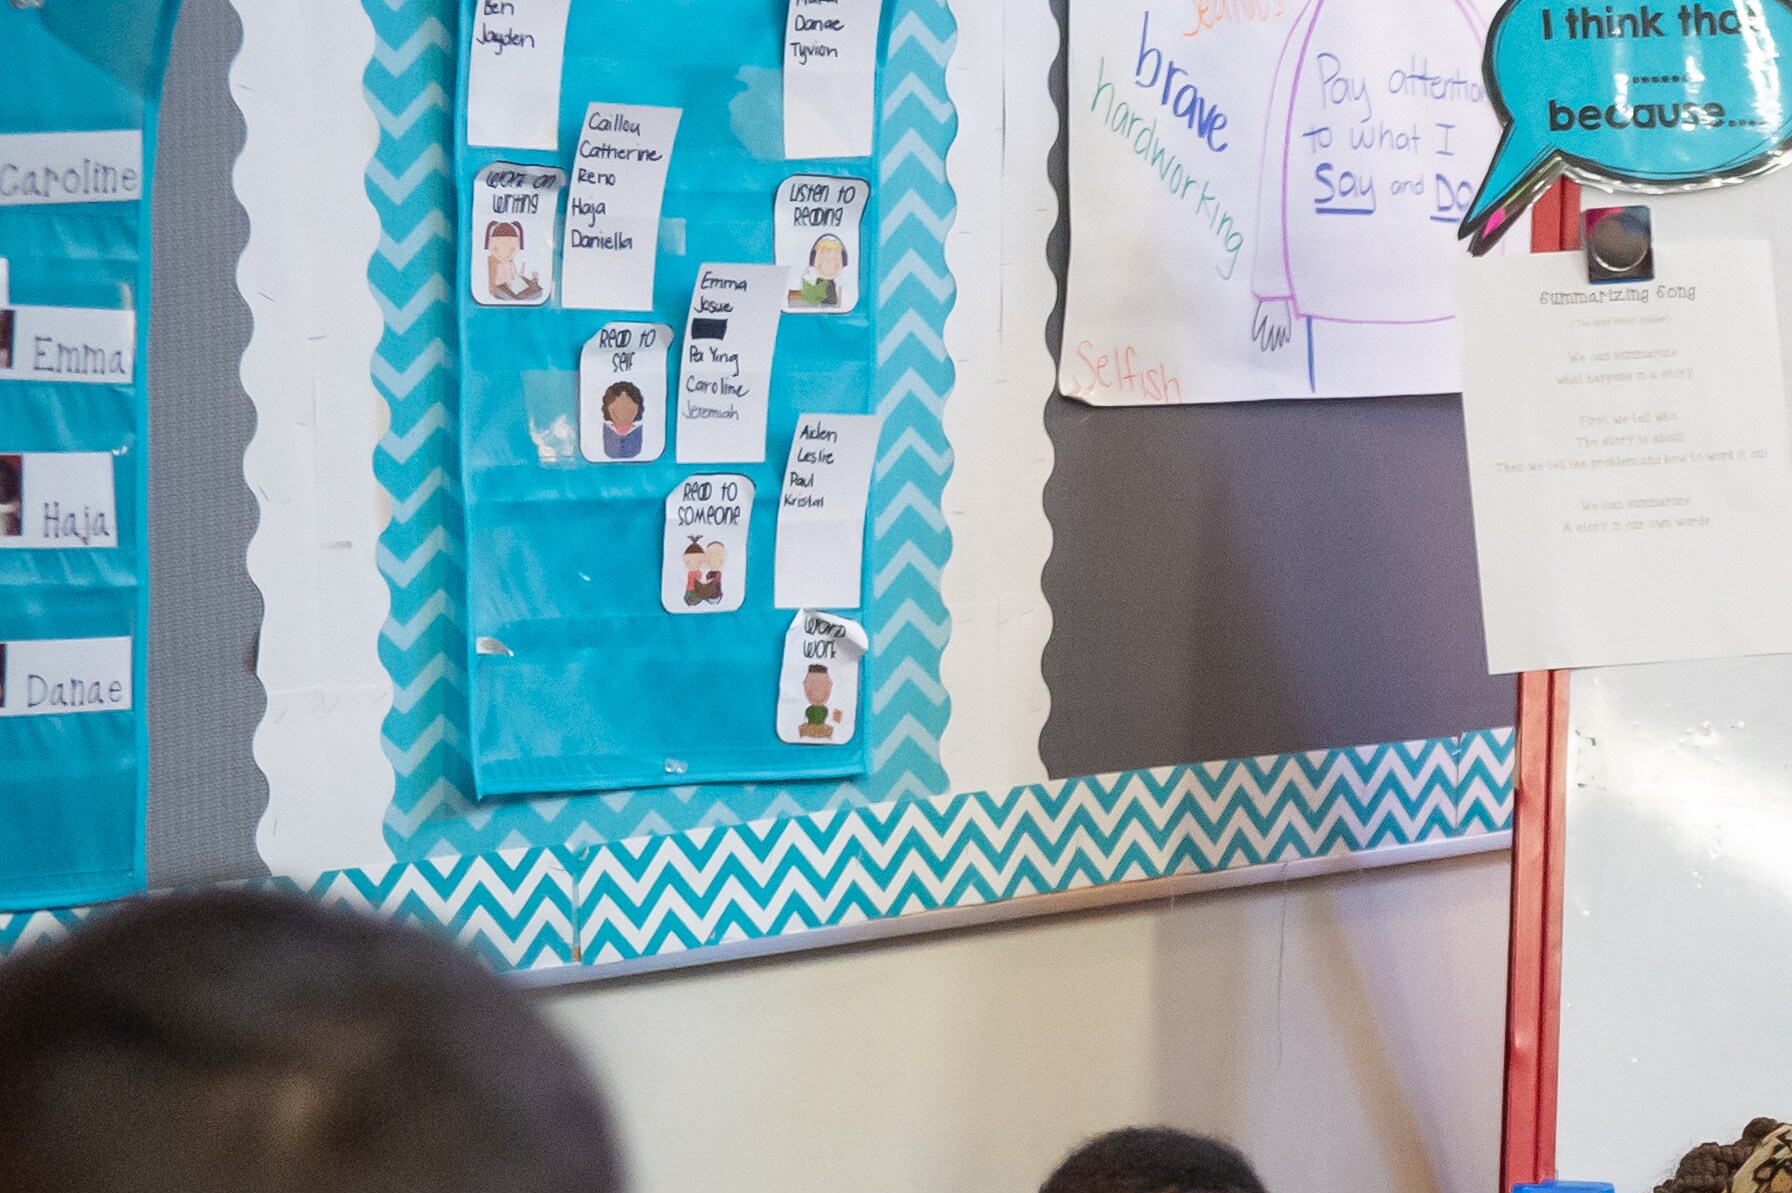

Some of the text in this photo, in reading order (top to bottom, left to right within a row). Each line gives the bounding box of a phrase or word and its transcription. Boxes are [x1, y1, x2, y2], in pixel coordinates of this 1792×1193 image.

[476, 22, 535, 55] Jayden
[1541, 8, 1554, 40] I
[1564, 4, 1667, 39] think
[1135, 11, 1228, 153] brave
[1316, 52, 1487, 121] Pay attentio
[579, 140, 663, 162] Catherine
[1303, 127, 1332, 153] to
[1435, 123, 1456, 157] I
[0, 158, 138, 196] Caroline
[1091, 57, 1244, 281] hardworking
[1313, 163, 1377, 213] Say
[1390, 176, 1425, 197] and
[571, 197, 606, 228] Haja
[571, 229, 633, 249] Daniella
[700, 271, 748, 292] Emma
[1539, 284, 1696, 307] Summarizing Song
[33, 337, 127, 375] Emma
[1073, 340, 1182, 402] Selfish
[685, 375, 750, 397] Caroline
[42, 502, 112, 545] Haja
[27, 673, 123, 708] Danae
